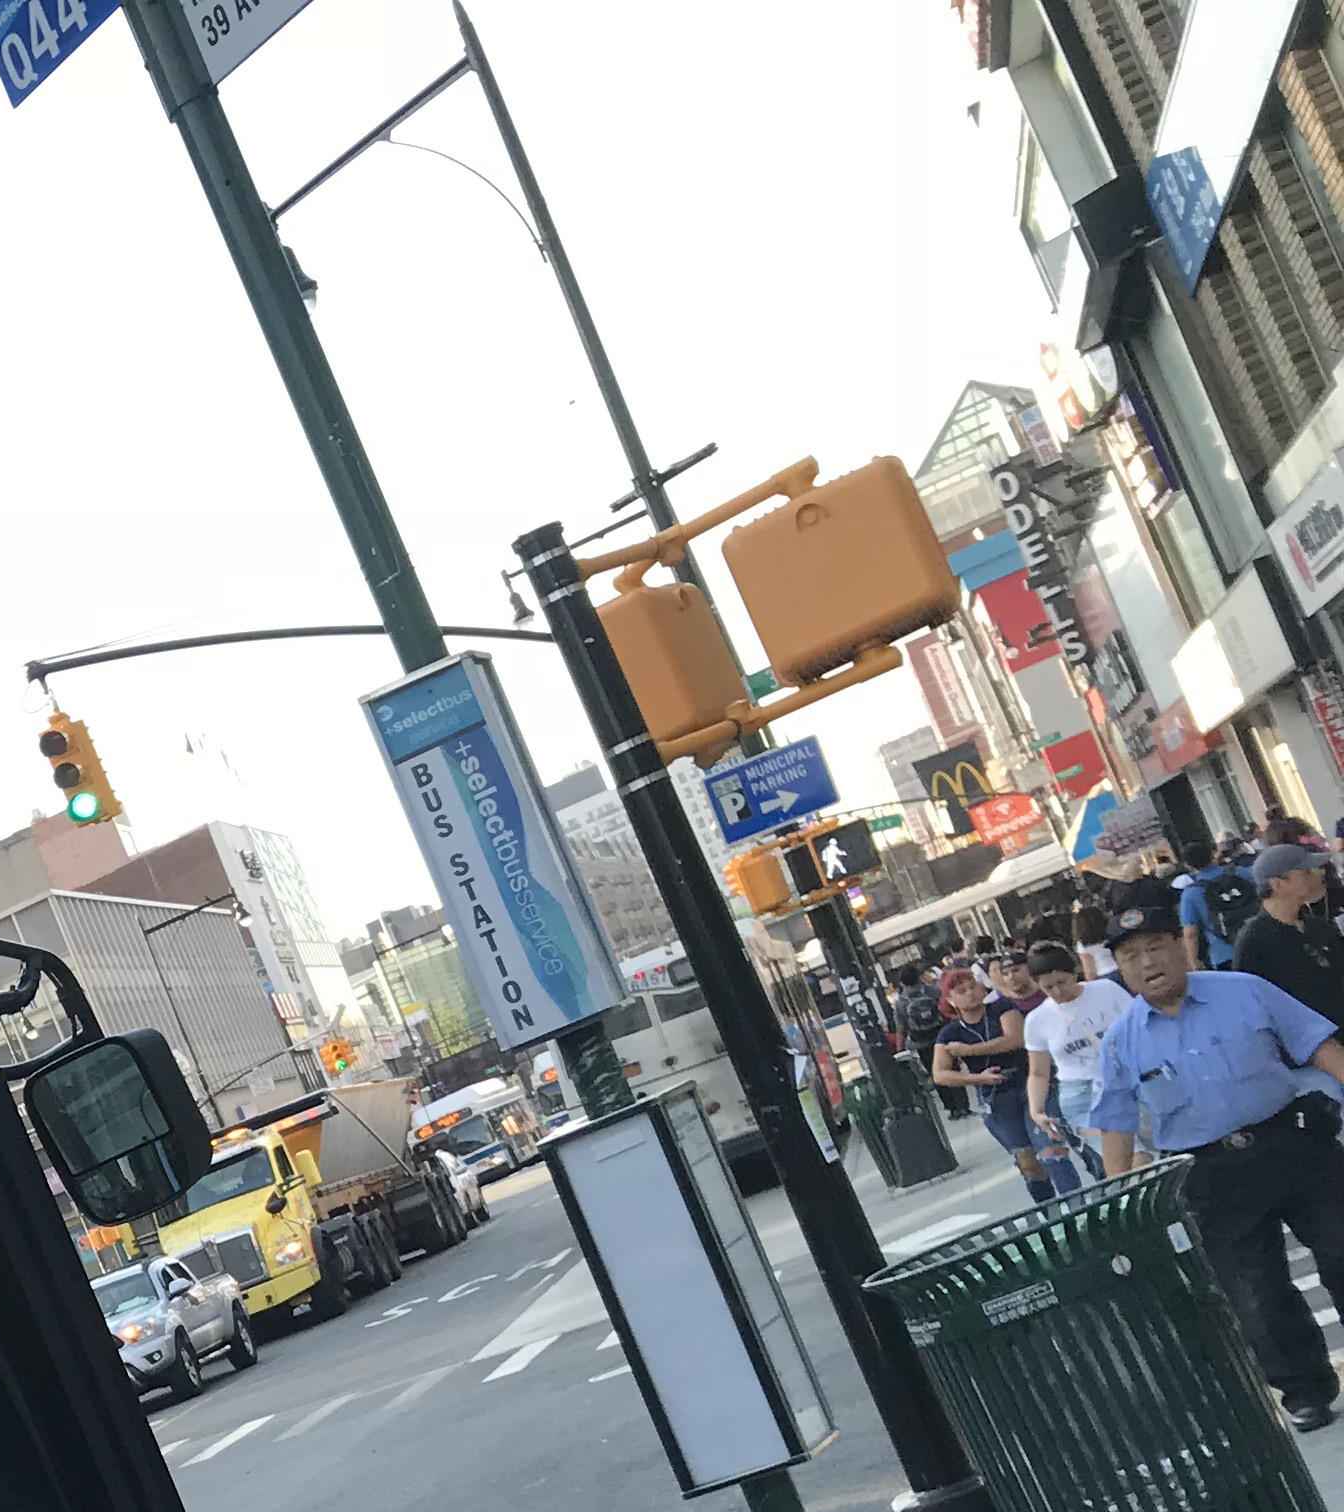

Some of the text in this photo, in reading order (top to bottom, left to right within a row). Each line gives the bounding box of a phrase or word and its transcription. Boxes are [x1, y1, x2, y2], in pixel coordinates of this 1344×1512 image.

[200, 4, 231, 47] 39
[744, 745, 814, 781] MUNICIPAL
[750, 764, 808, 797] PARKING
[719, 792, 747, 825] P
[411, 762, 535, 1031] BUS STATION
